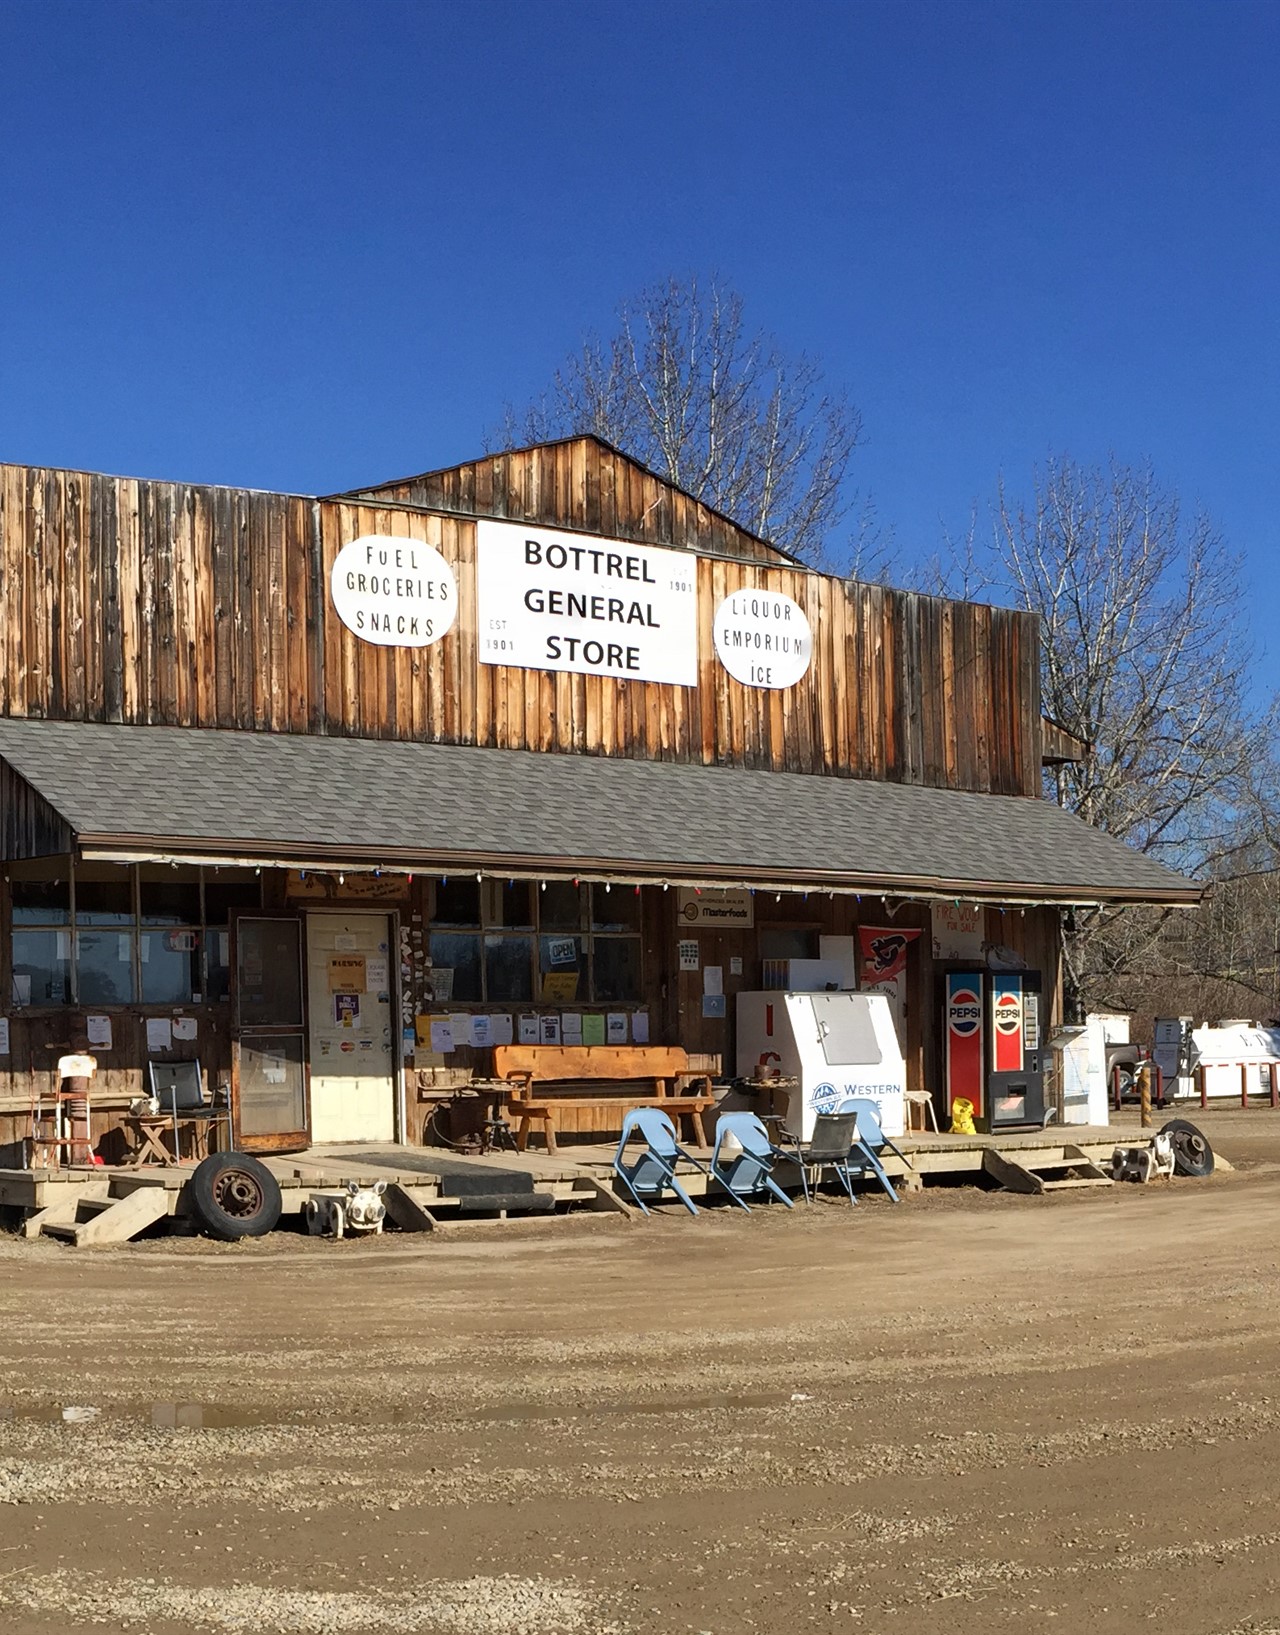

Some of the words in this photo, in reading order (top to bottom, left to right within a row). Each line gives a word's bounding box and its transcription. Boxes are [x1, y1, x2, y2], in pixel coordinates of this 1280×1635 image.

[366, 546, 418, 569] FUEL
[524, 540, 656, 583] BOTTREL
[346, 572, 448, 600] GROCERIES
[670, 580, 693, 593] 1901
[524, 588, 661, 628] GENERAL
[356, 610, 434, 637] SNACKS
[489, 619, 508, 630] EST
[486, 639, 514, 651] 1901
[724, 629, 802, 655] EMPORIUM
[546, 635, 641, 671] STORE
[702, 907, 748, 918] Masterfoods
[551, 943, 574, 957] OPEN
[949, 1007, 980, 1018] PEPSI
[995, 1009, 1020, 1019] PEPSI
[844, 1084, 901, 1096] WESTERN
